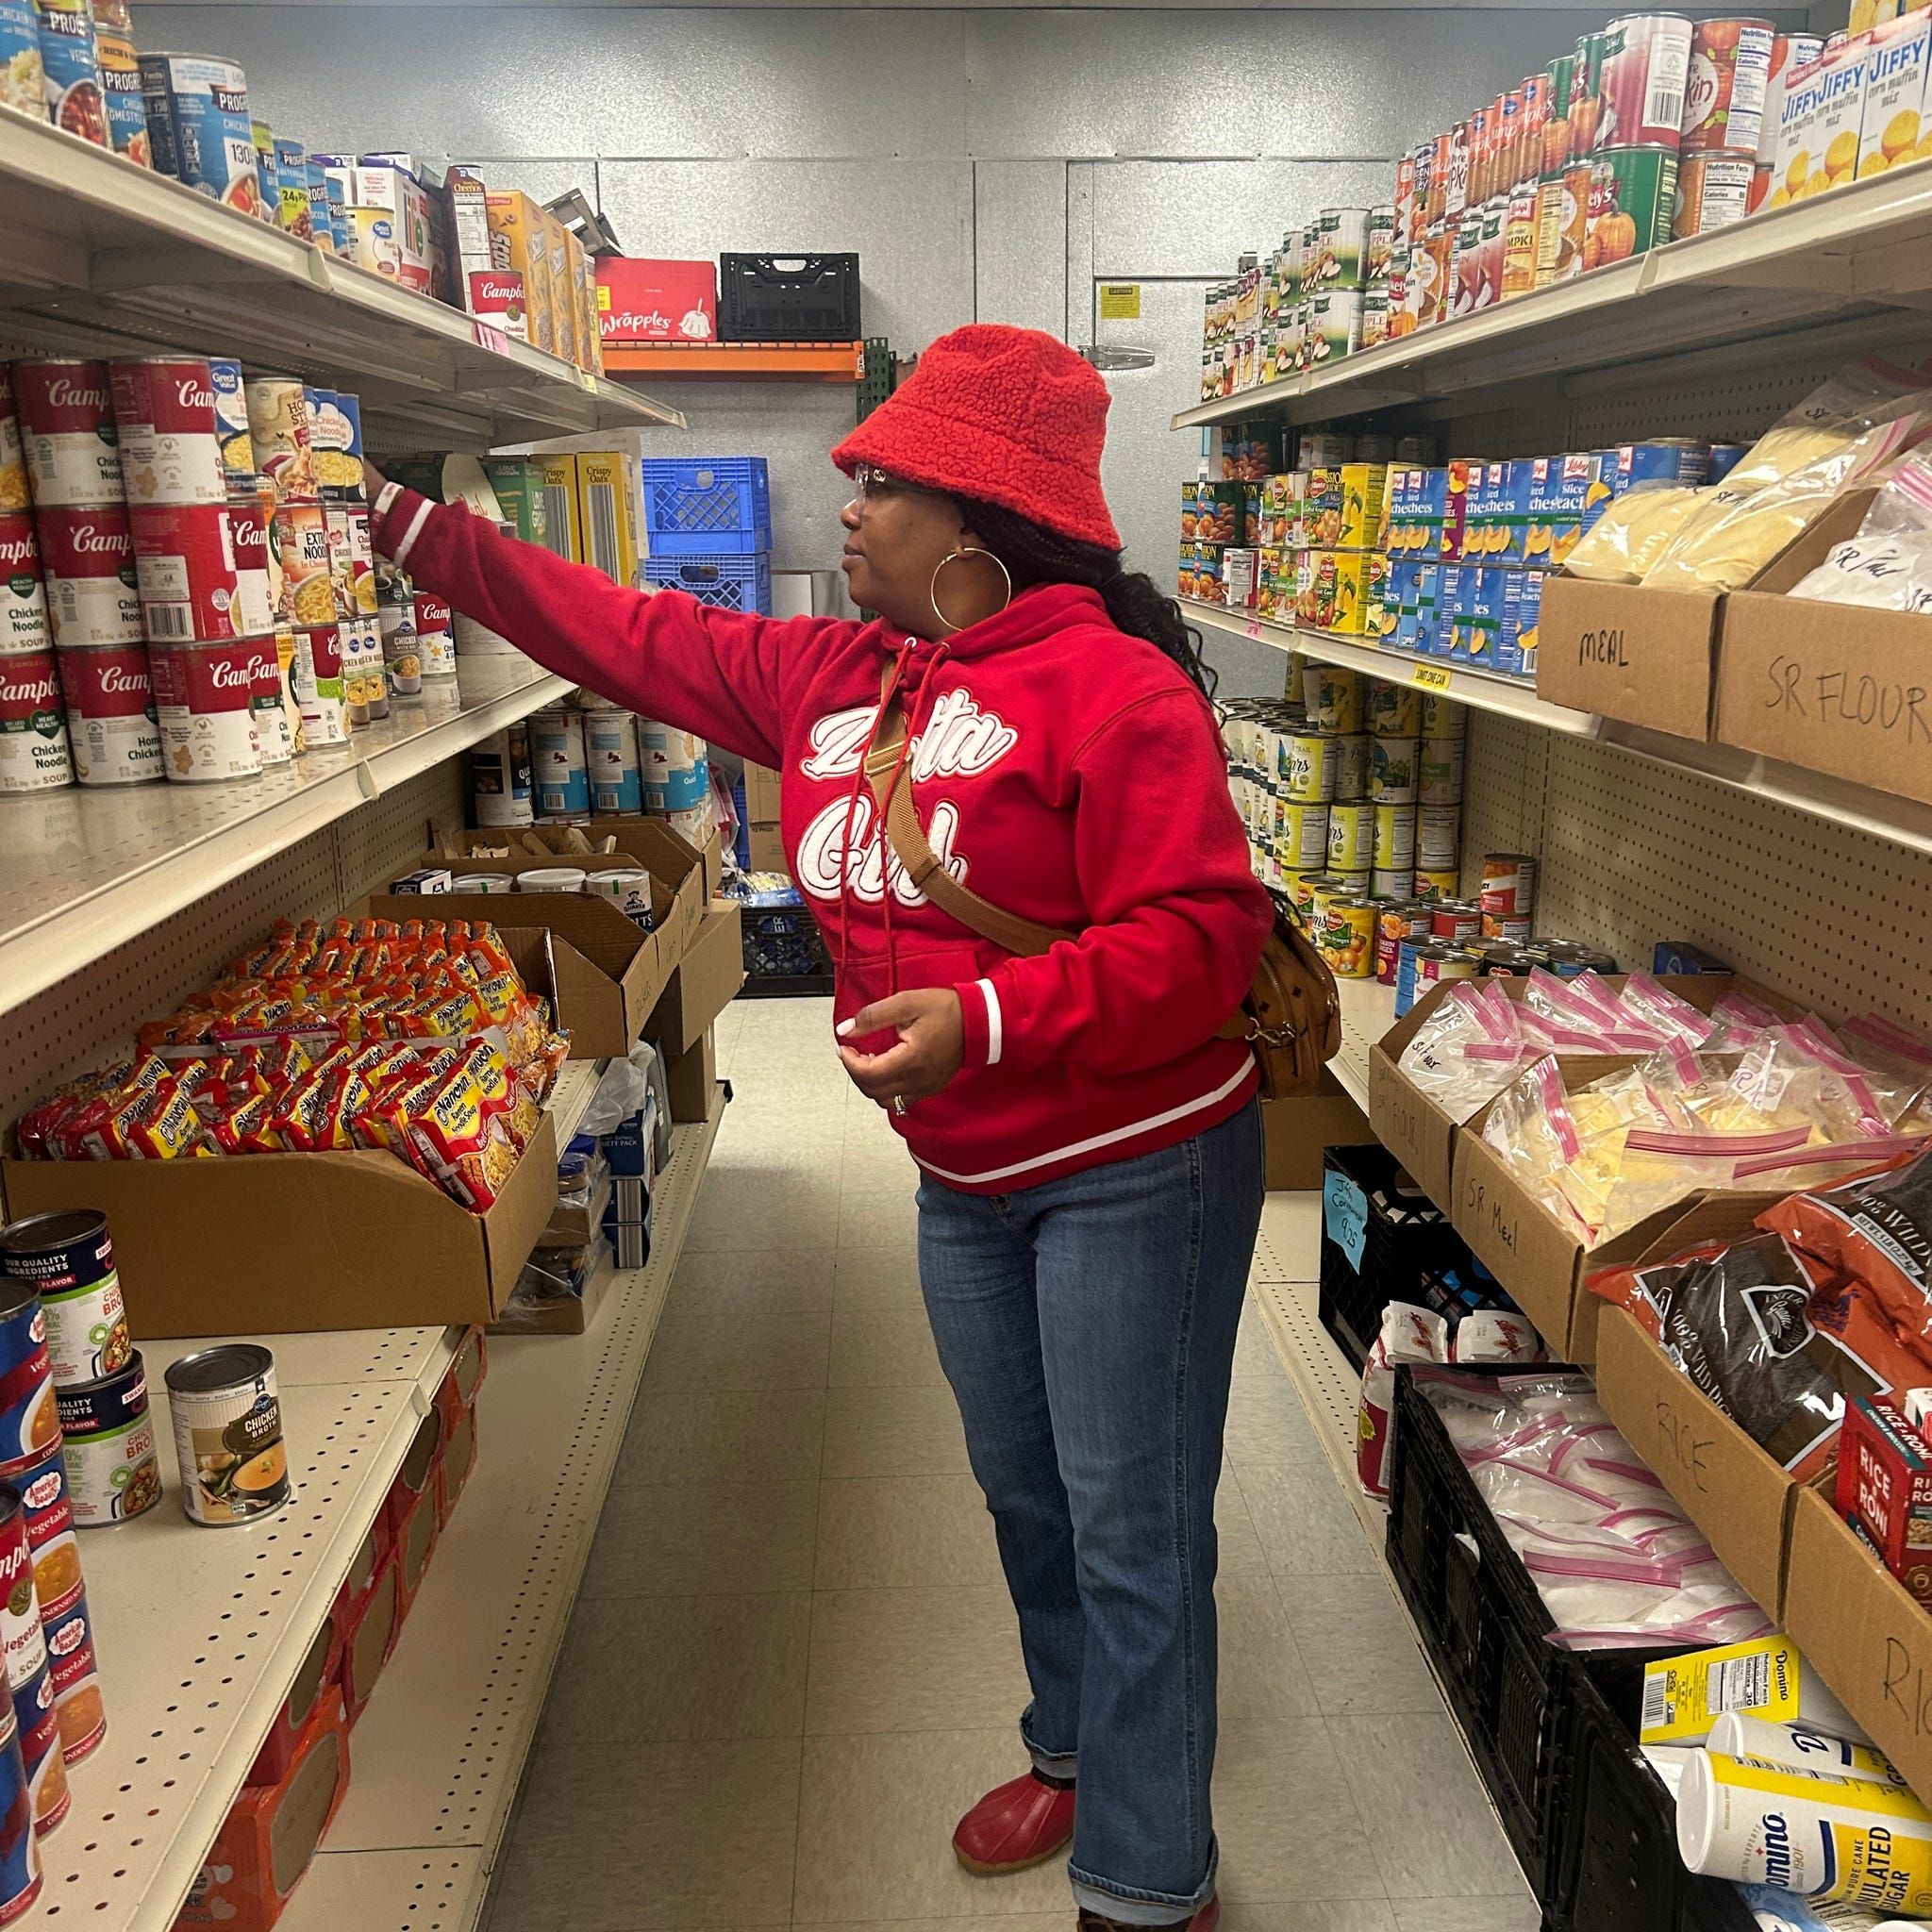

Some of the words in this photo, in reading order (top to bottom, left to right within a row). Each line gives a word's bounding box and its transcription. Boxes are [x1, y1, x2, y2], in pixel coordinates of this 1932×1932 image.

[1869, 38, 1926, 83] JIFFY
[1818, 63, 1866, 104] JIFFY
[219, 92, 247, 112] PROG
[1707, 163, 1734, 172] Nutrition
[212, 373, 235, 383] Great
[175, 380, 215, 408] Cam
[586, 465, 611, 476] Crispy
[590, 474, 609, 484] Oats
[70, 525, 131, 558] Camp
[234, 521, 267, 547] Cam
[8, 608, 43, 620] Chicken
[12, 621, 44, 632] Noodle
[20, 637, 44, 648] SOUP
[1579, 629, 1629, 668] MEAL
[97, 666, 152, 693] Cam
[1416, 669, 1428, 679] LIMIT
[1427, 672, 1437, 683] ONE
[1435, 675, 1447, 686] CAN
[1764, 655, 1807, 717] SR
[1816, 671, 1932, 745] FLOUR
[139, 737, 160, 747] Hom
[801, 688, 1018, 784] Zta
[31, 743, 67, 757] Chicken
[35, 756, 68, 770] Noodle
[42, 774, 69, 785] SOUP
[797, 793, 970, 907] Gil
[1468, 1177, 1486, 1214] SR
[1883, 1209, 1932, 1257] WILD
[22, 1254, 68, 1267] QUALITY
[41, 1276, 73, 1289] FLAVOR
[103, 1295, 122, 1317] BRO
[65, 1421, 96, 1430] FLAVOR
[244, 1405, 278, 1433] CHICKEN
[1875, 1404, 1903, 1430] RICE
[251, 1420, 277, 1439] BROTH
[125, 1437, 152, 1459] BRO
[1859, 1445, 1891, 1501] RICE
[1859, 1482, 1889, 1538] RONI
[1774, 1649, 1790, 1702] Domino
[1745, 1691, 1754, 1707] 30
[1762, 1812, 1790, 1888] omino
[1854, 1839, 1865, 1866] CANE
[1847, 1867, 1862, 1890] PURE
[1878, 1870, 1911, 1910] SUGAR
